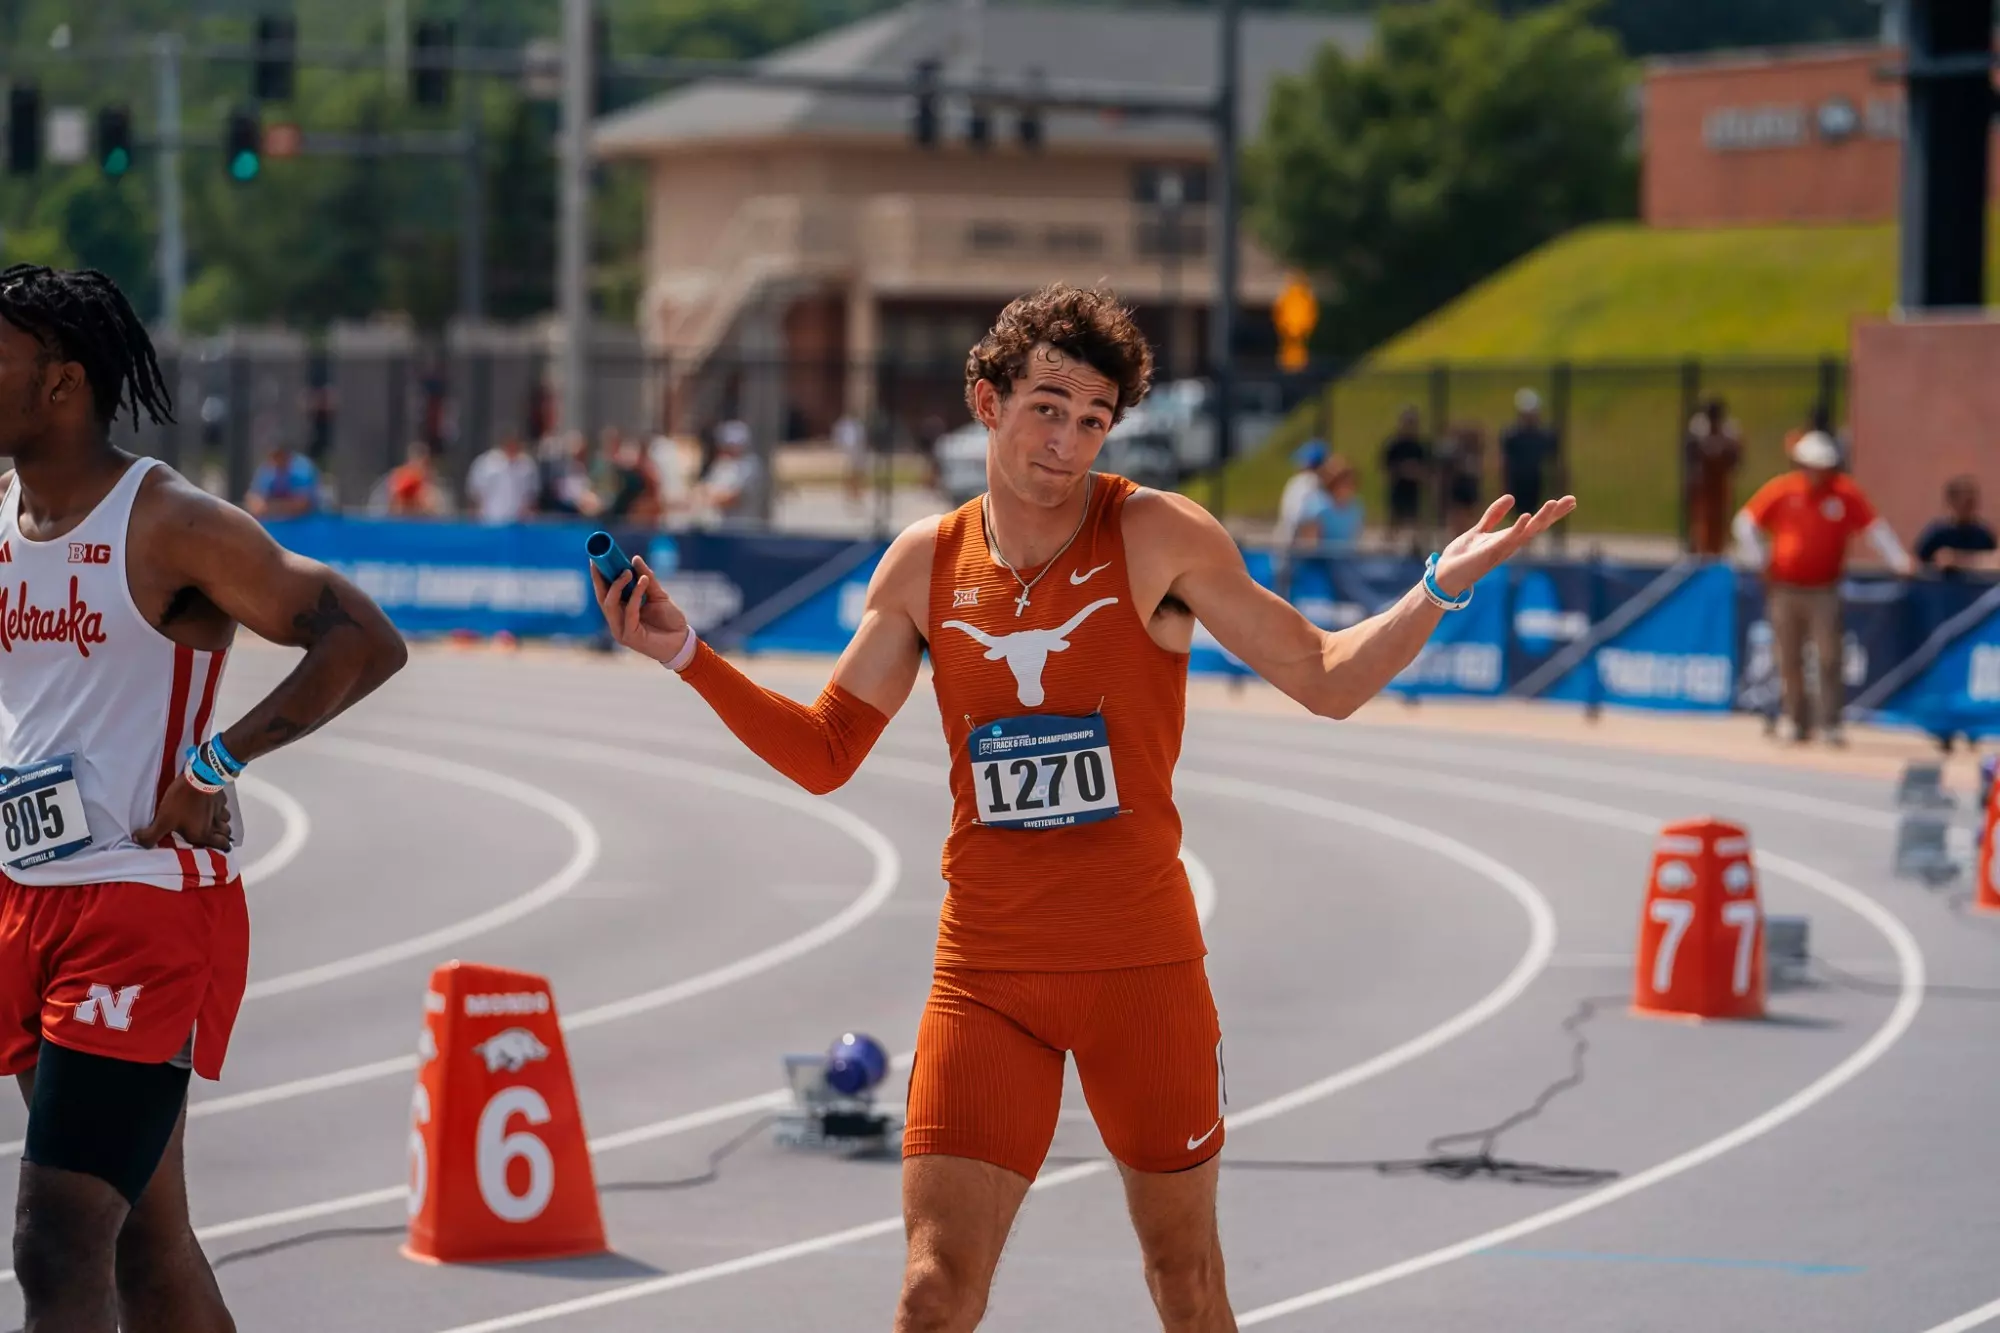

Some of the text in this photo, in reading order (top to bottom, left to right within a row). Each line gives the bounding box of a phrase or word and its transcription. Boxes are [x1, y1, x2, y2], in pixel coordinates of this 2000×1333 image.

[993, 739, 1013, 749] TRACK
[1013, 739, 1018, 748] &
[1019, 737, 1037, 747] FIELD
[1037, 730, 1094, 745] CHAMPIONSHIPS
[984, 751, 1105, 813] 1270
[2, 787, 64, 852] 805
[1066, 816, 1075, 824] AR
[1650, 899, 1695, 993] 7
[1721, 901, 1757, 997] 7
[73, 983, 144, 1032] N
[475, 1086, 555, 1223] 6
